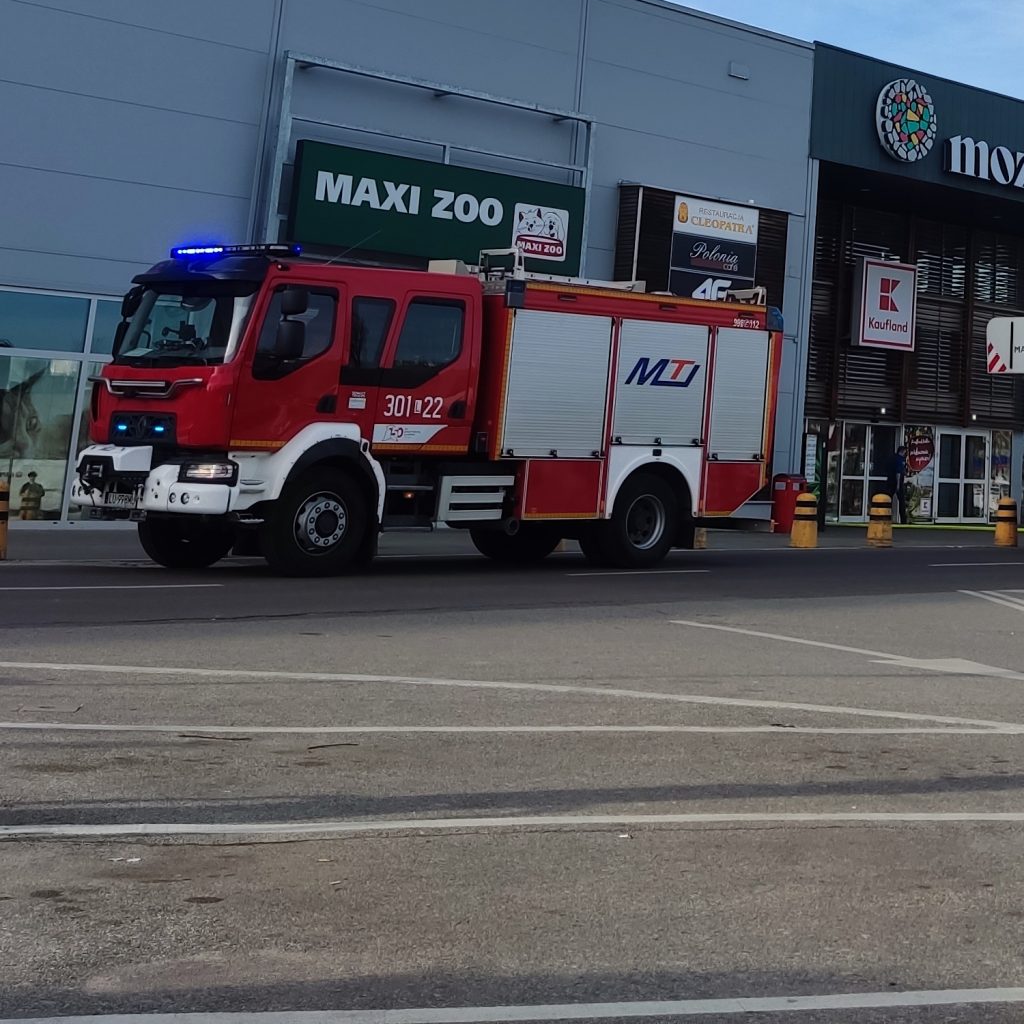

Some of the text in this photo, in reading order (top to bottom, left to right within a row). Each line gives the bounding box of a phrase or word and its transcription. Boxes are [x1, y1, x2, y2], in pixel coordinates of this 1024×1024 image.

[315, 170, 504, 227] MAXI ZOO
[699, 207, 744, 221] RESTAURACJA
[690, 216, 753, 234] CLEOPATRA
[517, 240, 563, 255] MAXI ZOO
[690, 241, 739, 264] Polonia
[868, 316, 908, 333] Kaufland
[383, 394, 412, 418] 301
[422, 396, 443, 418] 22
